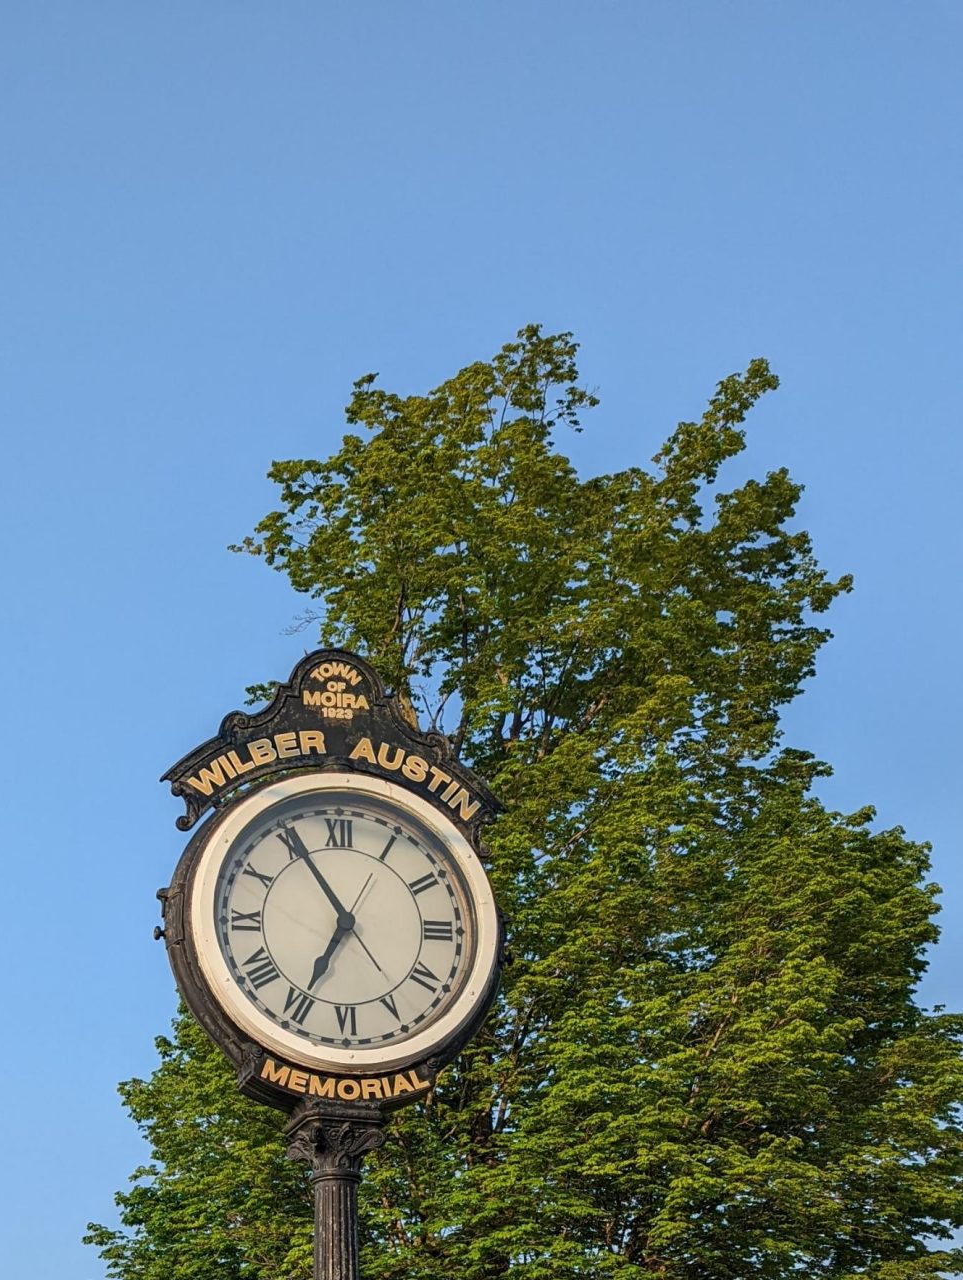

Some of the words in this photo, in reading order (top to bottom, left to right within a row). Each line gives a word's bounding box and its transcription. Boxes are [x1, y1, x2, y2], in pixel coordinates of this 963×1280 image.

[310, 661, 363, 686] TOWN
[326, 681, 347, 693] OF
[303, 690, 371, 711] MOIRA
[188, 730, 326, 796] WILBER
[350, 738, 481, 821] AUSTIN
[325, 818, 354, 848] XII
[242, 861, 274, 889] X
[408, 872, 439, 895] II
[231, 909, 262, 933] IX
[423, 919, 454, 942] III
[242, 946, 281, 991] VIII
[410, 961, 442, 993] IV
[283, 986, 315, 1025] VII
[381, 995, 401, 1022] V
[334, 1005, 357, 1036] VI
[261, 1060, 430, 1099] MEMORIAL
